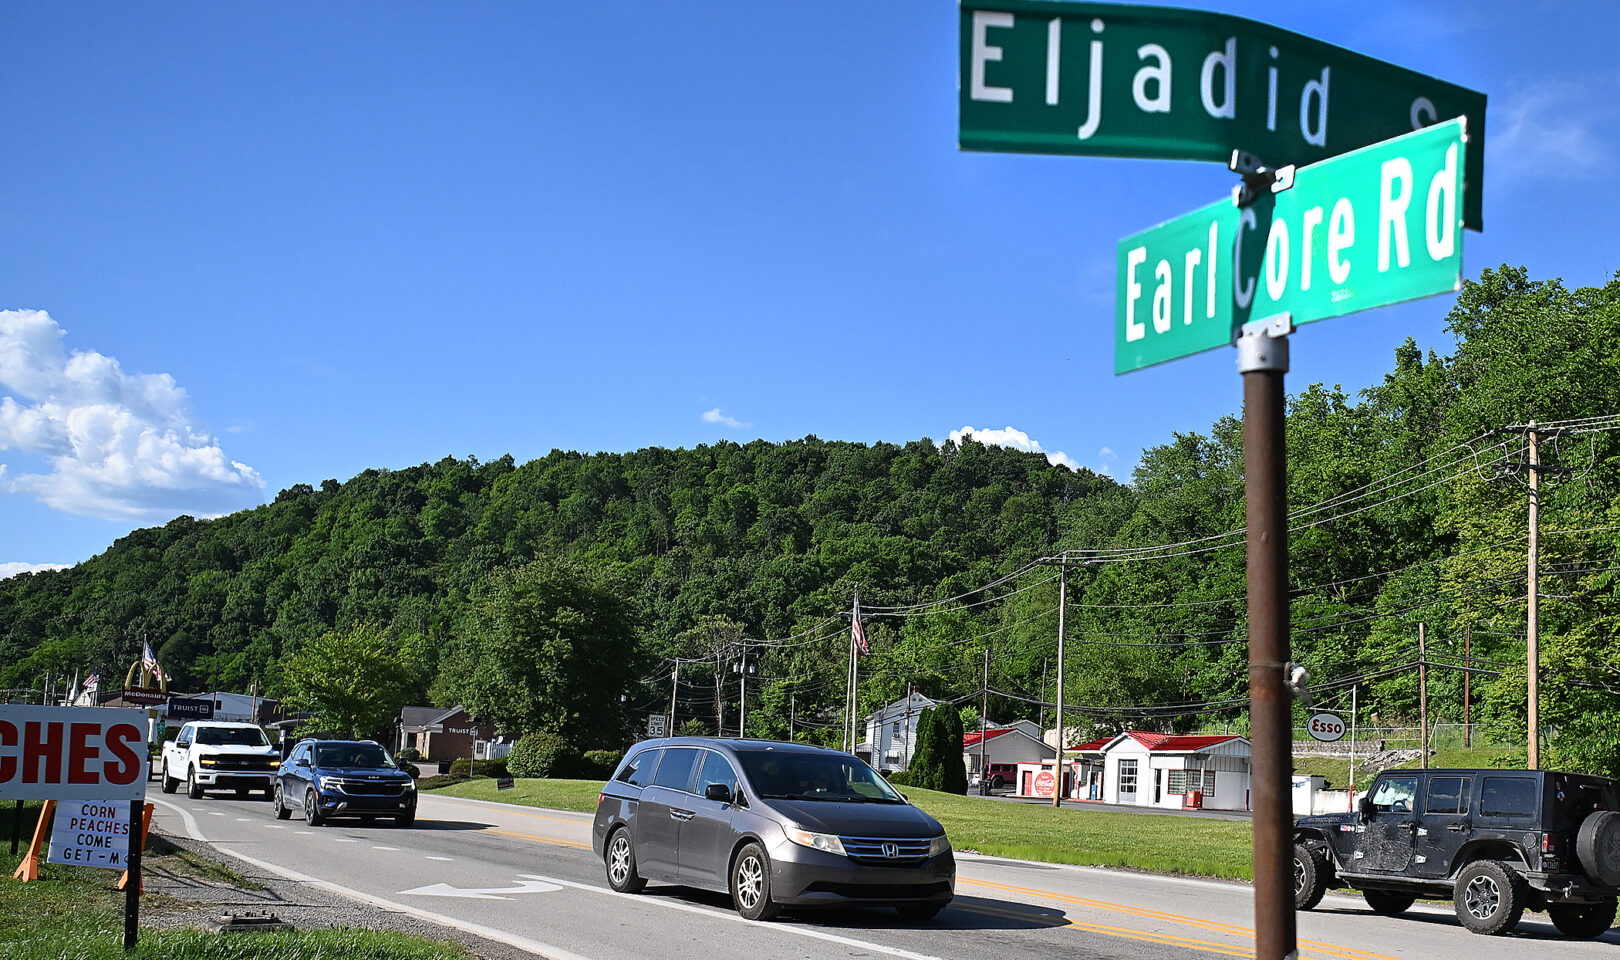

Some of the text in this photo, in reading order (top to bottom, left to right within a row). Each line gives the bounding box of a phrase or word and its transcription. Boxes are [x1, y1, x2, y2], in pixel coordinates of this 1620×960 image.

[970, 10, 1331, 148] Eljadid
[1126, 142, 1458, 343] Earl Core Rd
[124, 690, 167, 700] McDonald's
[172, 704, 199, 712] TRUIST
[649, 726, 664, 735] 35
[81, 804, 116, 819] CORN
[70, 817, 129, 835] PEACHES
[77, 833, 113, 848] COME
